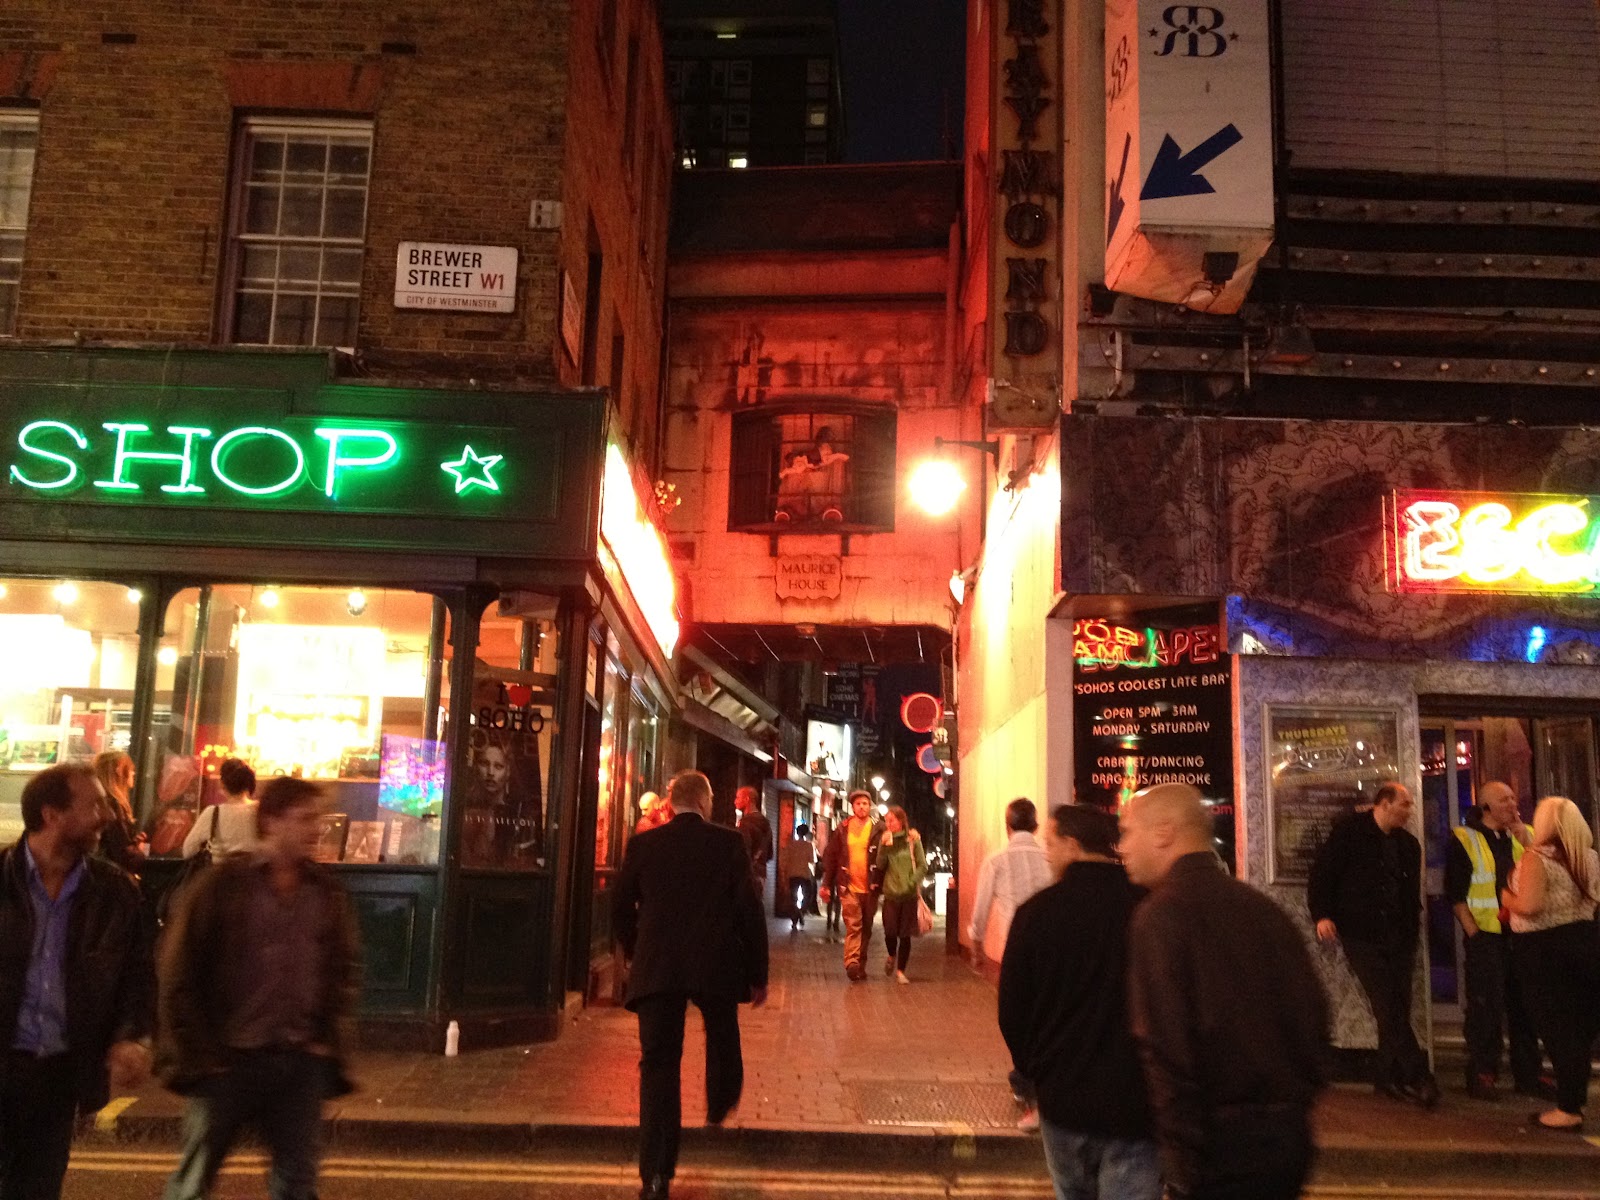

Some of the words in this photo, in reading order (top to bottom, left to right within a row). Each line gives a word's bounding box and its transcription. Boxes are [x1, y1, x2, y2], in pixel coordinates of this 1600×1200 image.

[408, 249, 482, 268] BREWER
[407, 269, 473, 288] STREET
[480, 273, 505, 290] W1
[406, 295, 425, 304] CITY
[427, 297, 438, 305] OF
[440, 298, 498, 308] WESTMINSTER
[10, 419, 398, 499] SHOP
[1402, 500, 1600, 585] ESC
[781, 563, 837, 575] MAURICE
[788, 579, 828, 591] HOUSE
[835, 684, 854, 692] SOHO
[1118, 678, 1168, 692] COOLEST
[1171, 675, 1198, 688] LATE
[830, 693, 860, 701] CINEMAS
[1103, 708, 1133, 720] OPEN
[1138, 706, 1162, 718] 5PM
[1172, 704, 1198, 716] 3AM
[479, 706, 544, 734] SOHO
[1092, 724, 1141, 736] MONDAY
[1150, 721, 1211, 734] SATURDAY
[1278, 725, 1347, 740] THURSDAYS
[1091, 773, 1124, 785] DRAG
